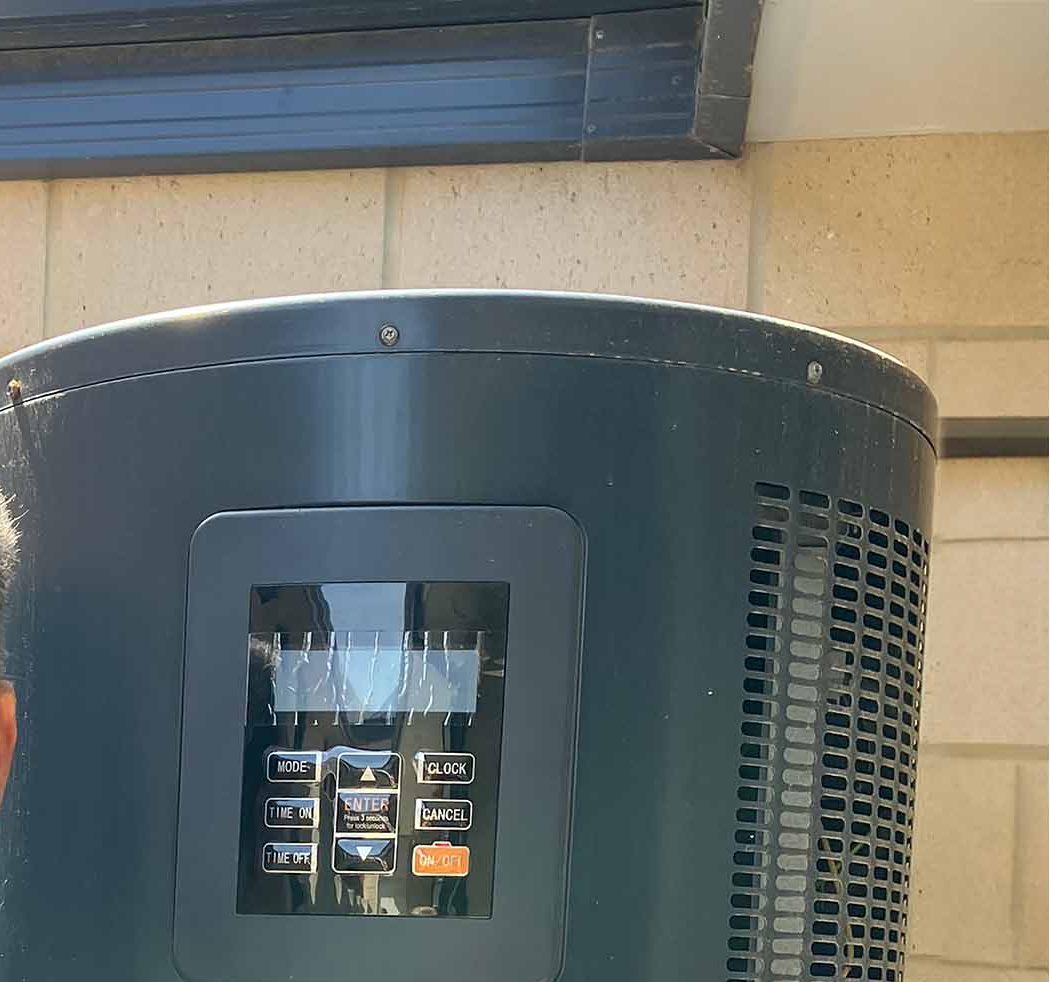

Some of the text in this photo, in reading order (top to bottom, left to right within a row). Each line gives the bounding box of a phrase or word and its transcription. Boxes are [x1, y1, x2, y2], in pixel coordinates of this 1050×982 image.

[277, 760, 307, 773] MODE
[427, 761, 467, 775] CLOCK
[344, 797, 390, 812] ENTER
[269, 807, 313, 819] TIME ON
[360, 813, 365, 822] 3
[422, 808, 468, 821] CANCEL
[266, 851, 312, 865] TIME OFF
